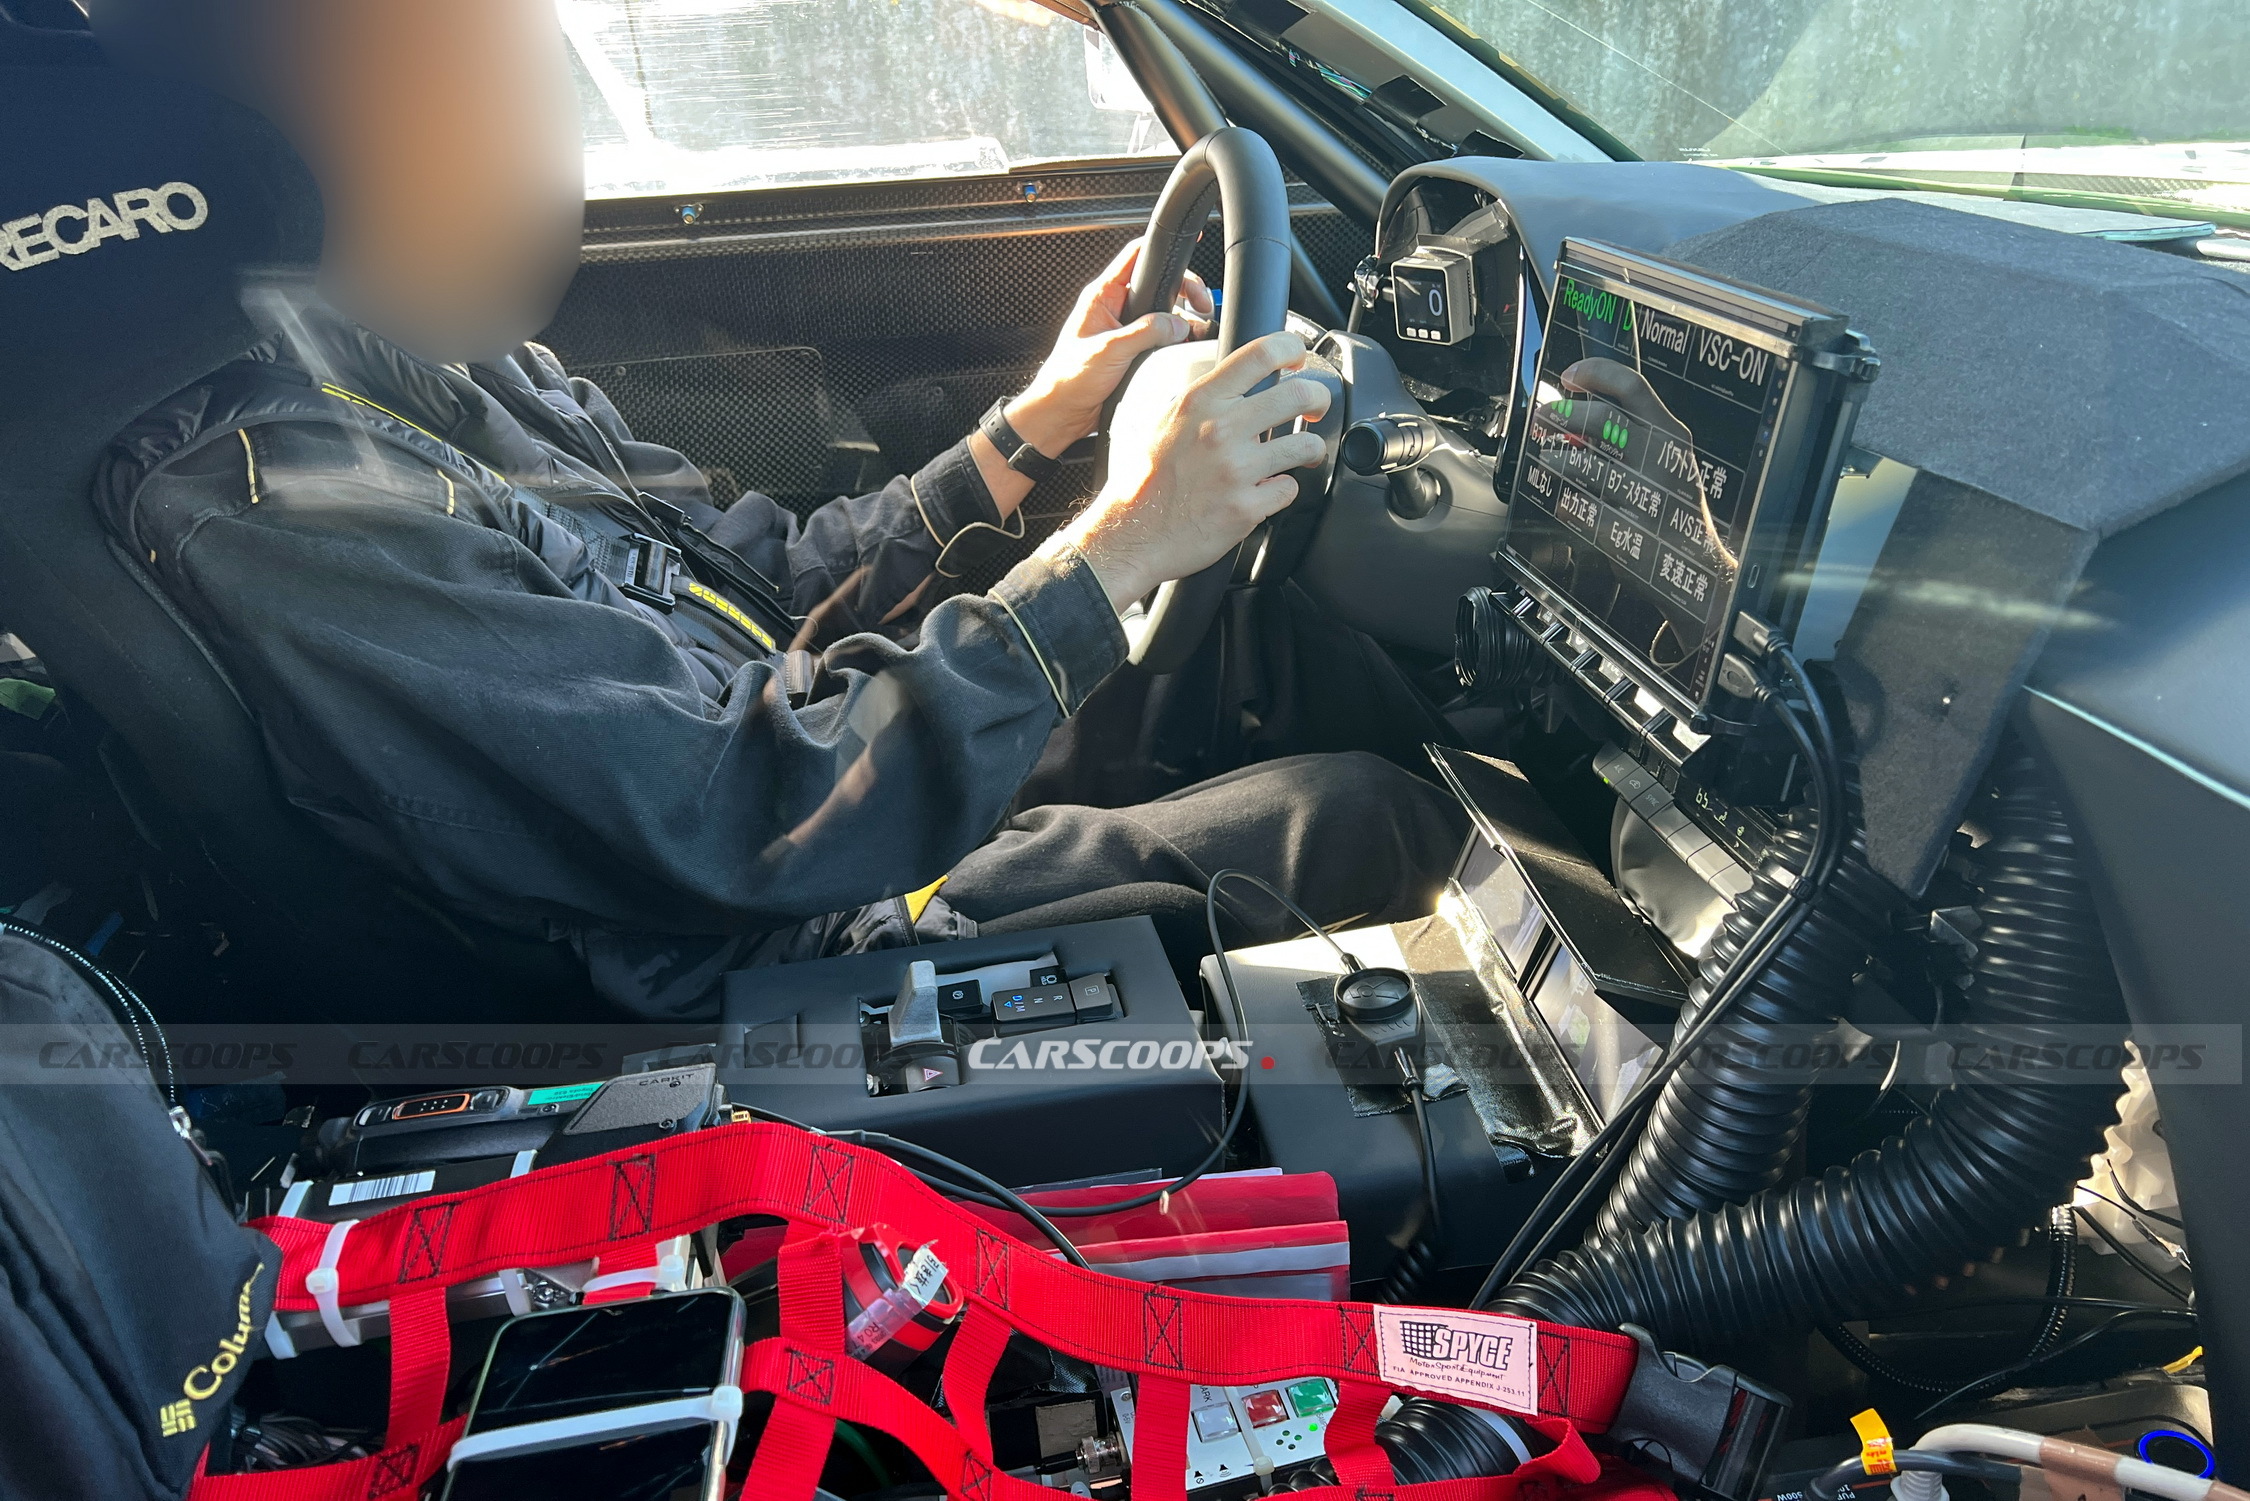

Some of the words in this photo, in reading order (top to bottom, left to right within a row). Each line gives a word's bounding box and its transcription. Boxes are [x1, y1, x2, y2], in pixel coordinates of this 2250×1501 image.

[1429, 289, 1443, 317] 0
[1563, 278, 1617, 325] ReadyON
[1640, 308, 1691, 355] Normal
[1699, 329, 1769, 386] VSC-ON
[1560, 487, 1598, 527] 出力正常
[1610, 521, 1643, 560] Eg水温
[1660, 552, 1708, 602] 変速正常
[639, 1073, 695, 1086] CARKIT
[184, 1262, 265, 1400] Colum
[1432, 1327, 1513, 1371] SPYCE
[1410, 1370, 1453, 1382] APPROVED
[1454, 1377, 1494, 1390] APPENDIX
